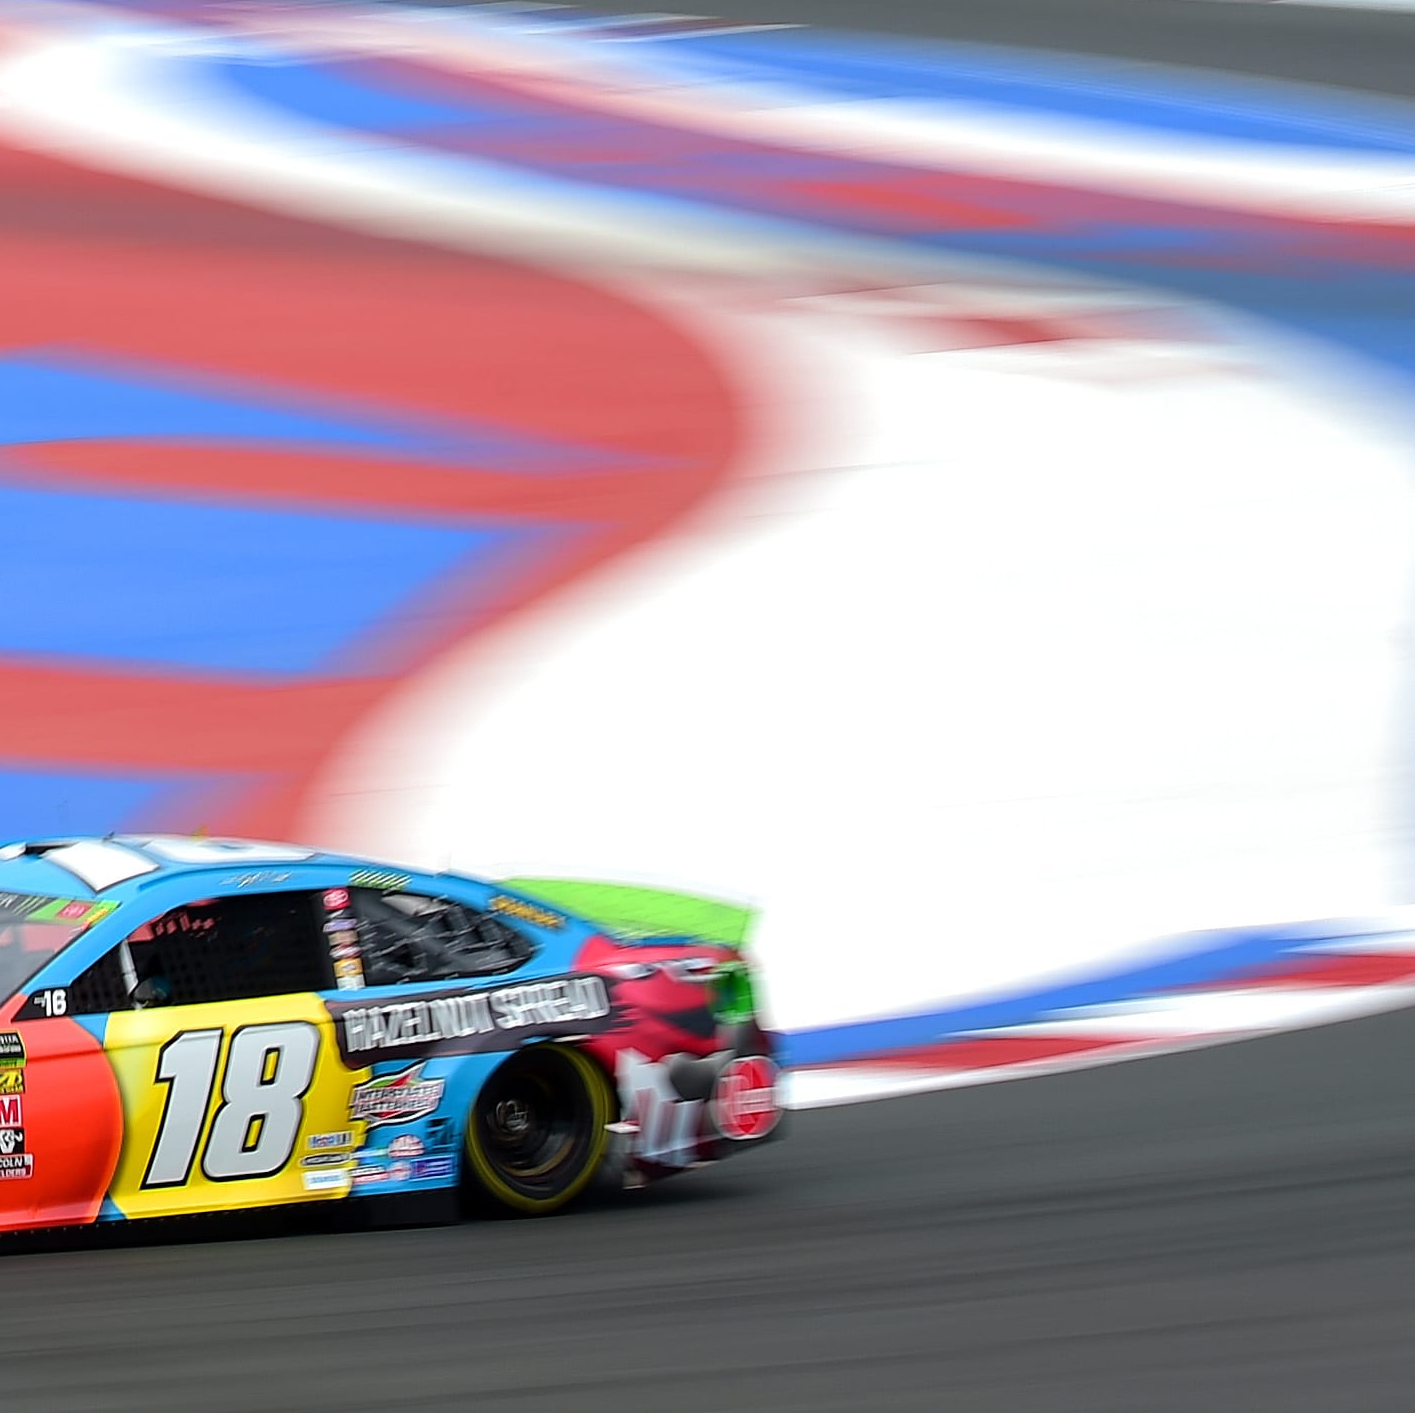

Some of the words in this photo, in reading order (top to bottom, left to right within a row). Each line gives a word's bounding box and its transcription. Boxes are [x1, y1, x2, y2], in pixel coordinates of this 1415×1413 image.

[342, 992, 496, 1053] HAZELNUT
[489, 977, 611, 1030] SPREAD
[139, 1020, 321, 1191] 18
